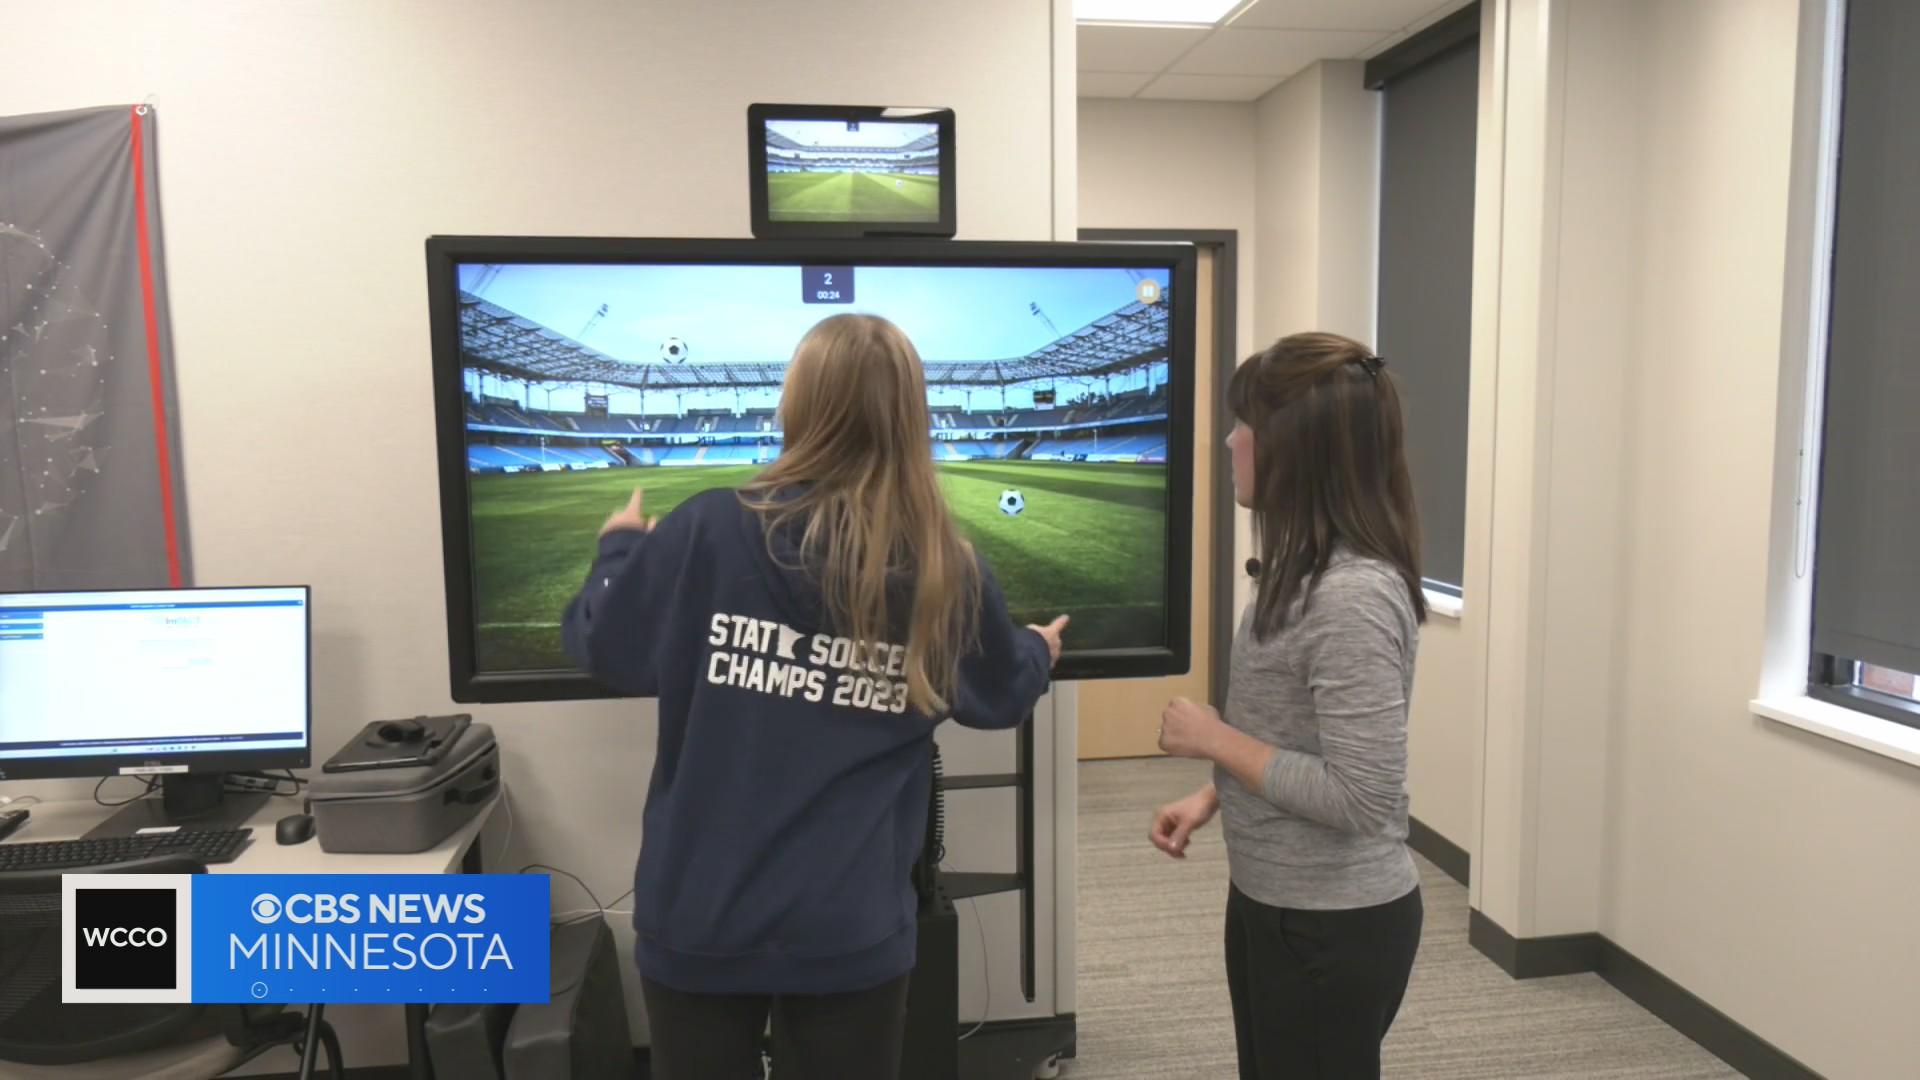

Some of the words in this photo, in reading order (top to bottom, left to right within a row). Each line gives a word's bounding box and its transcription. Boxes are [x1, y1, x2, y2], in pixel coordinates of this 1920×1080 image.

[823, 272, 833, 286] 2
[816, 290, 841, 300] 00:24
[706, 651, 827, 702] CHAMPS
[832, 675, 909, 714] 2023
